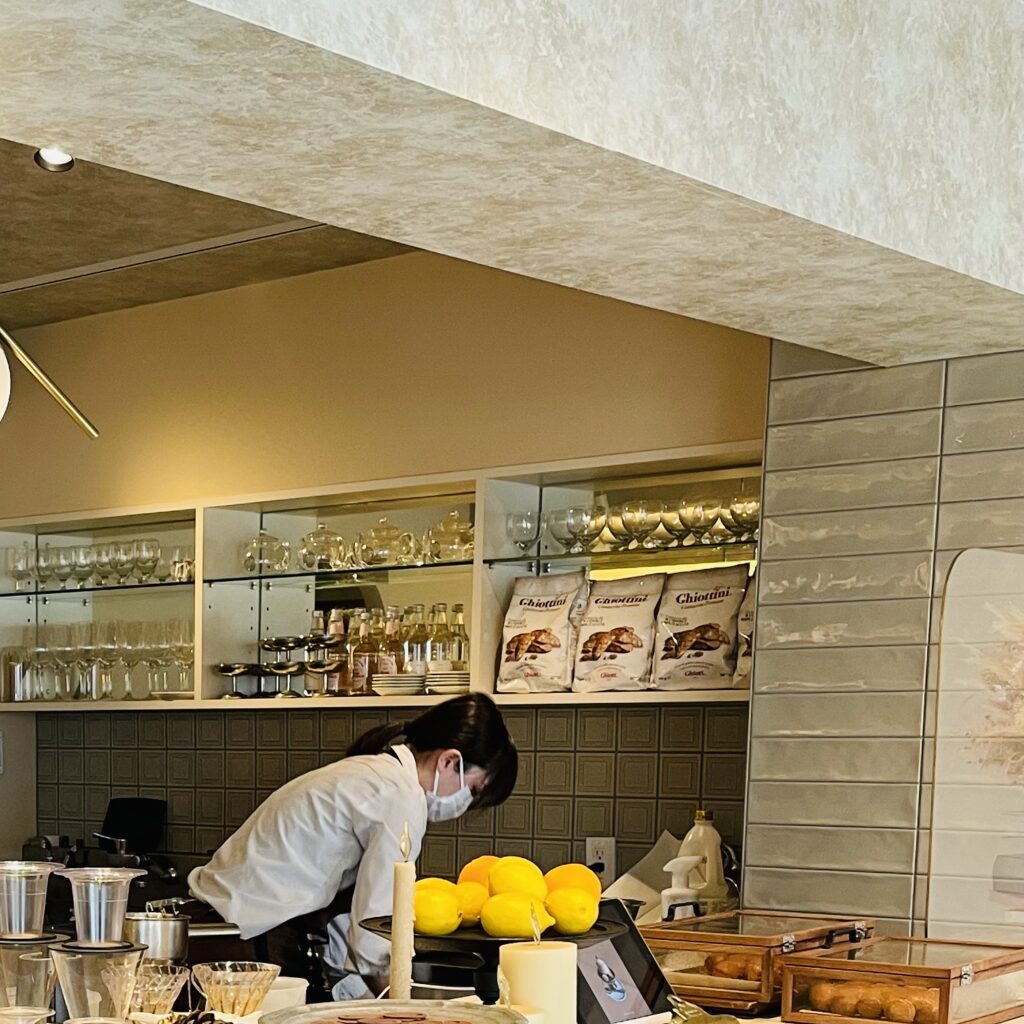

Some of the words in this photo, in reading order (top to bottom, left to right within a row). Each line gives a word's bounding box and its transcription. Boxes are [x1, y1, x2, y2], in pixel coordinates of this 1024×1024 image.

[594, 595, 648, 605] Ghiottini
[676, 587, 730, 604] Ghiottini
[519, 597, 567, 608] Ghiottini
